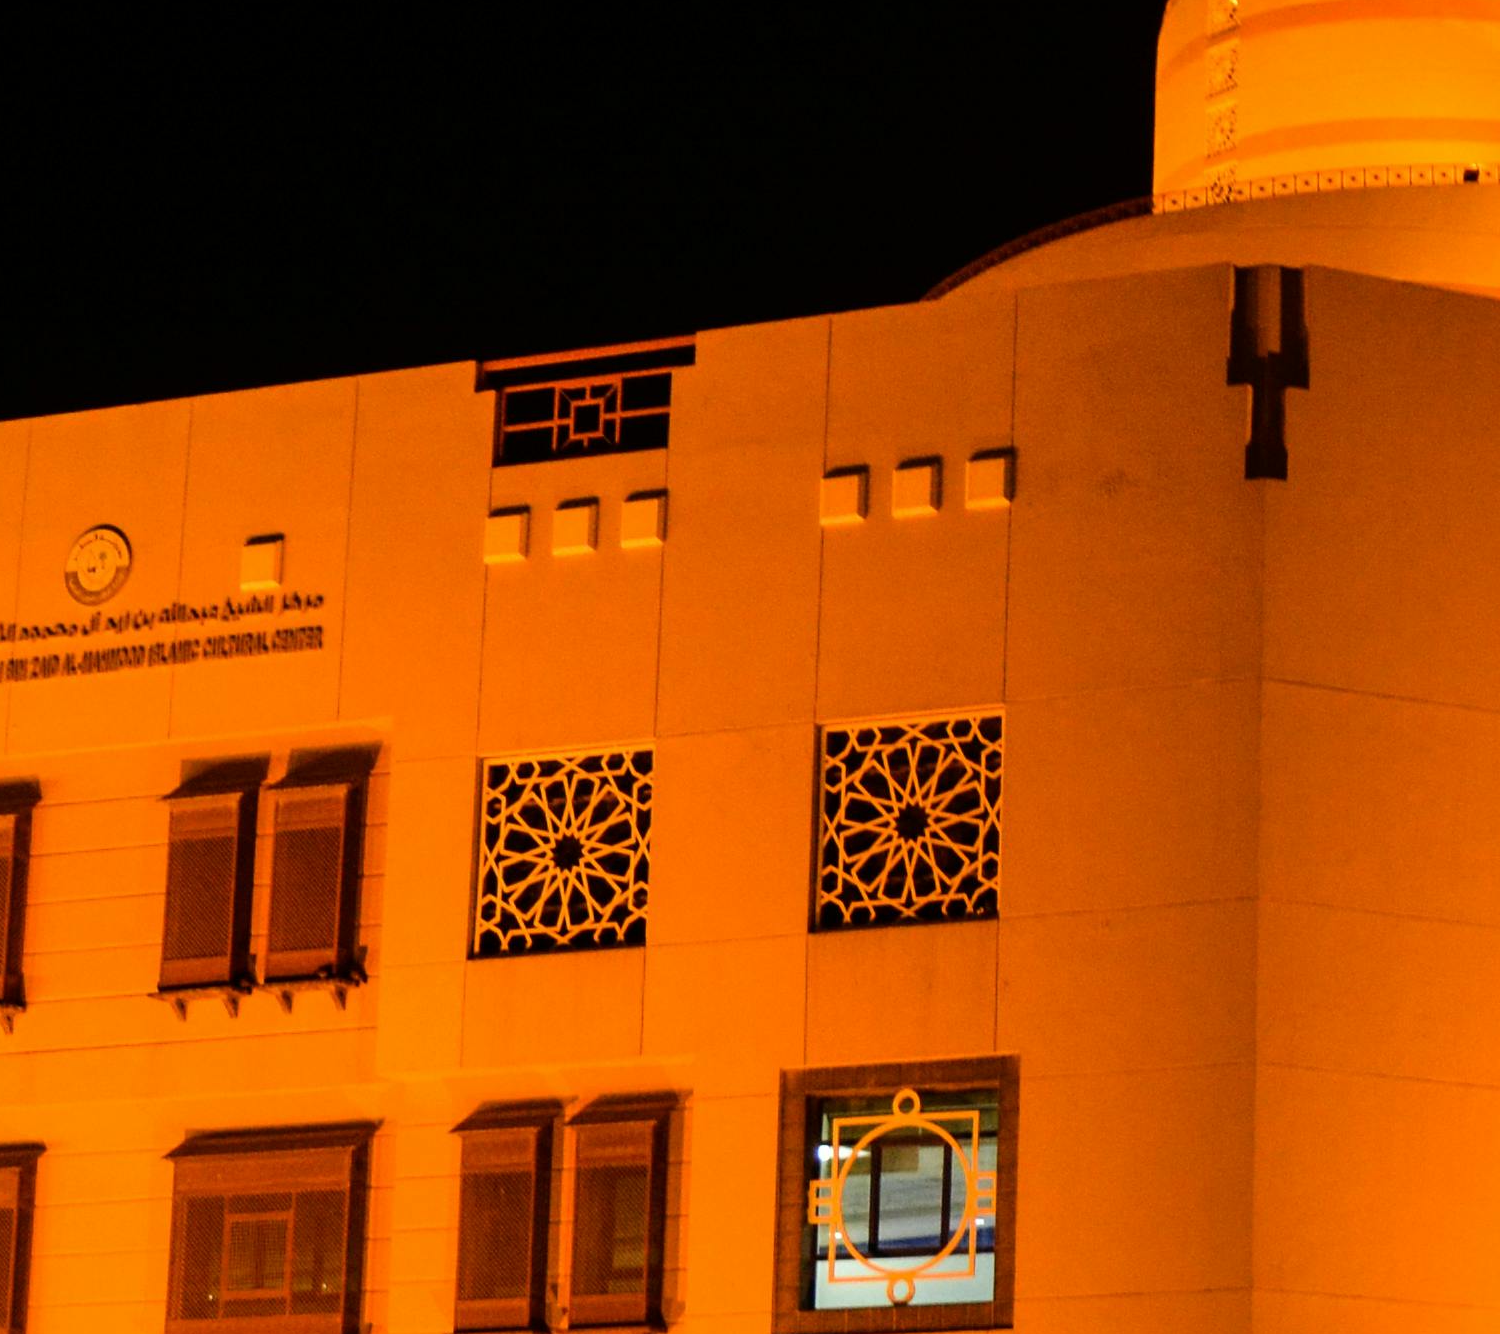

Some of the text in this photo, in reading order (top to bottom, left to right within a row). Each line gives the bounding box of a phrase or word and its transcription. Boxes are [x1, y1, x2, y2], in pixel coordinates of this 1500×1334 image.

[220, 591, 275, 621] الشيخ
[18, 619, 78, 643] محمود
[7, 658, 29, 681] BIN
[31, 654, 61, 679] ZAID
[148, 640, 201, 667] ISLAMIC
[203, 633, 268, 661] CULTURAL
